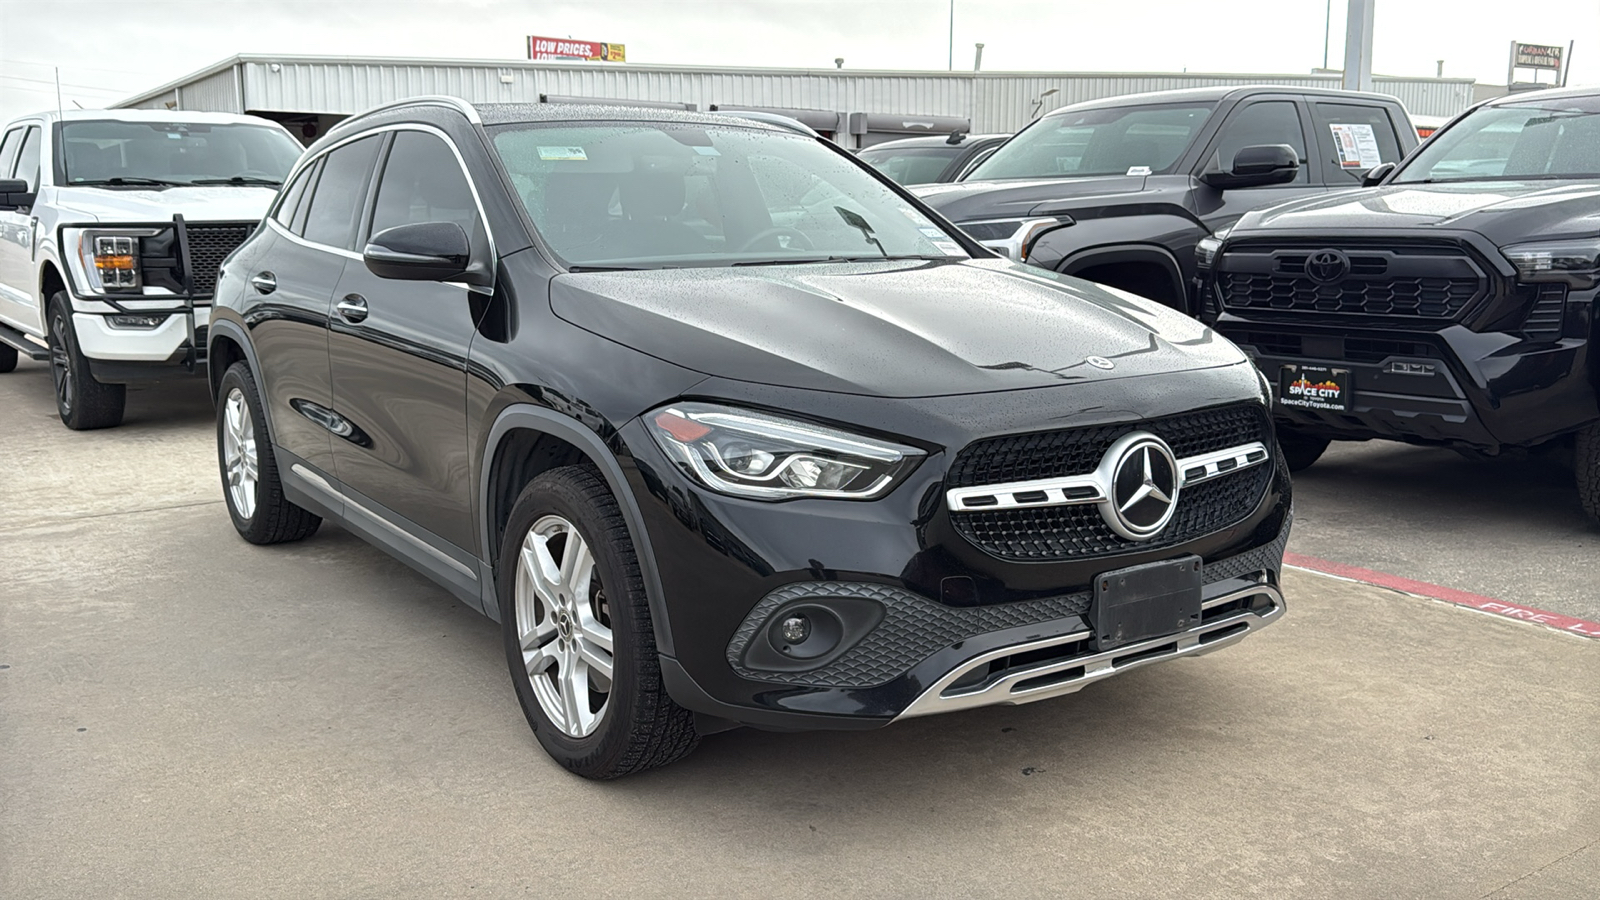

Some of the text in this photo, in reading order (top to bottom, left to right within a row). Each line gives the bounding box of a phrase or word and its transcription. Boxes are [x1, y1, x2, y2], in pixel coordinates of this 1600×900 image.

[535, 40, 557, 53] LOW
[557, 42, 593, 57] PRICES,
[1289, 386, 1340, 398] SPACE CITY
[1280, 397, 1345, 411] SpaceCityToyota.com
[1480, 602, 1559, 623] FIRE
